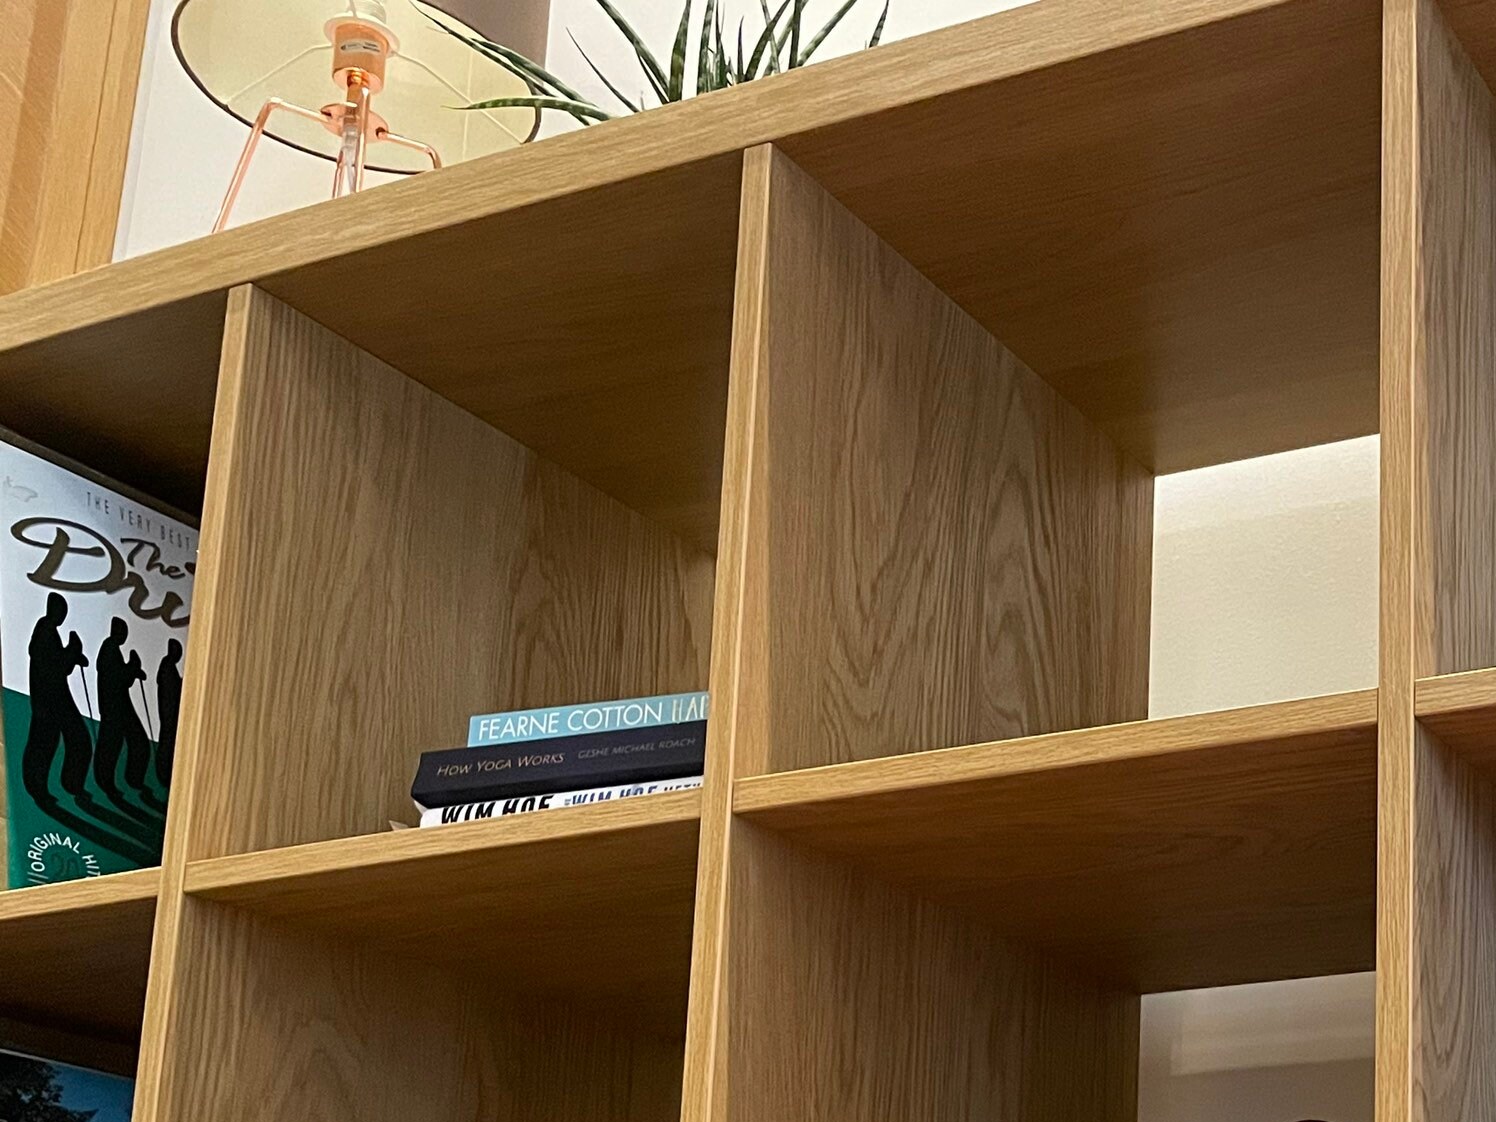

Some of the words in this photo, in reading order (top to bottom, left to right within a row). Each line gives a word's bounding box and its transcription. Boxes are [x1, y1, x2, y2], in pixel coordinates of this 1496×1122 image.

[86, 491, 110, 515] THE
[119, 505, 151, 533] VERY
[160, 525, 191, 553] BEST
[120, 537, 187, 580] The
[478, 712, 560, 741] FEARNE
[567, 701, 663, 731] COTTON
[436, 764, 473, 777] HOW
[476, 760, 512, 773] YOGA
[517, 752, 566, 769] WORKS
[611, 742, 656, 756] MICHAEL
[658, 737, 697, 750] ROACH
[441, 801, 496, 825] WIM
[28, 832, 80, 872] ORIGINAL
